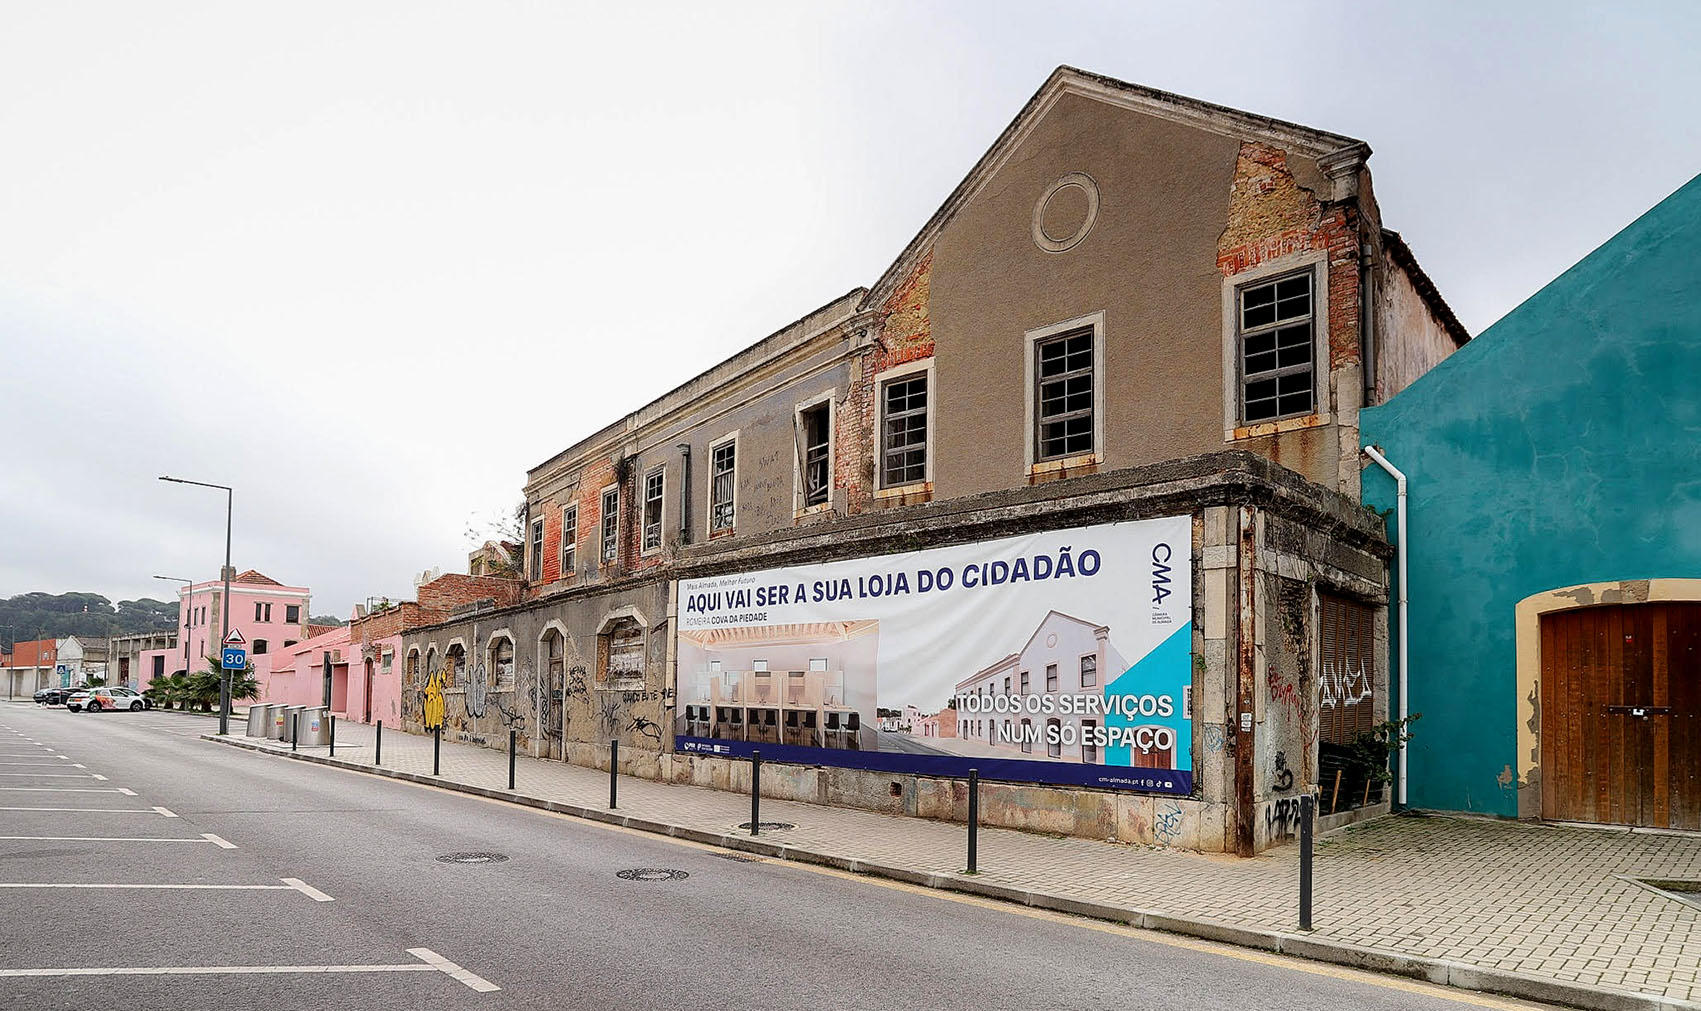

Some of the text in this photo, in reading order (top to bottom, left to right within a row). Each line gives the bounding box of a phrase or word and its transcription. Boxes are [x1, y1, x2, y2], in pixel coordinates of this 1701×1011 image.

[687, 545, 1102, 615] AQUI VAI SER A SUA LOJA DO CIDADÃO
[687, 576, 756, 591] Mais Almada, Melhor Futuro
[1152, 543, 1172, 604] CMA
[711, 615, 728, 625] COVA
[729, 614, 738, 624] DA
[739, 612, 768, 623] PIEDADE
[225, 654, 244, 664] 30
[956, 693, 1022, 714] TODOS
[1025, 694, 1055, 715] OS
[1059, 694, 1173, 721] SERVIÇOS
[997, 721, 1173, 755] NUM SÓ ESPAÇO
[1098, 776, 1139, 785] cm-almada.pt
